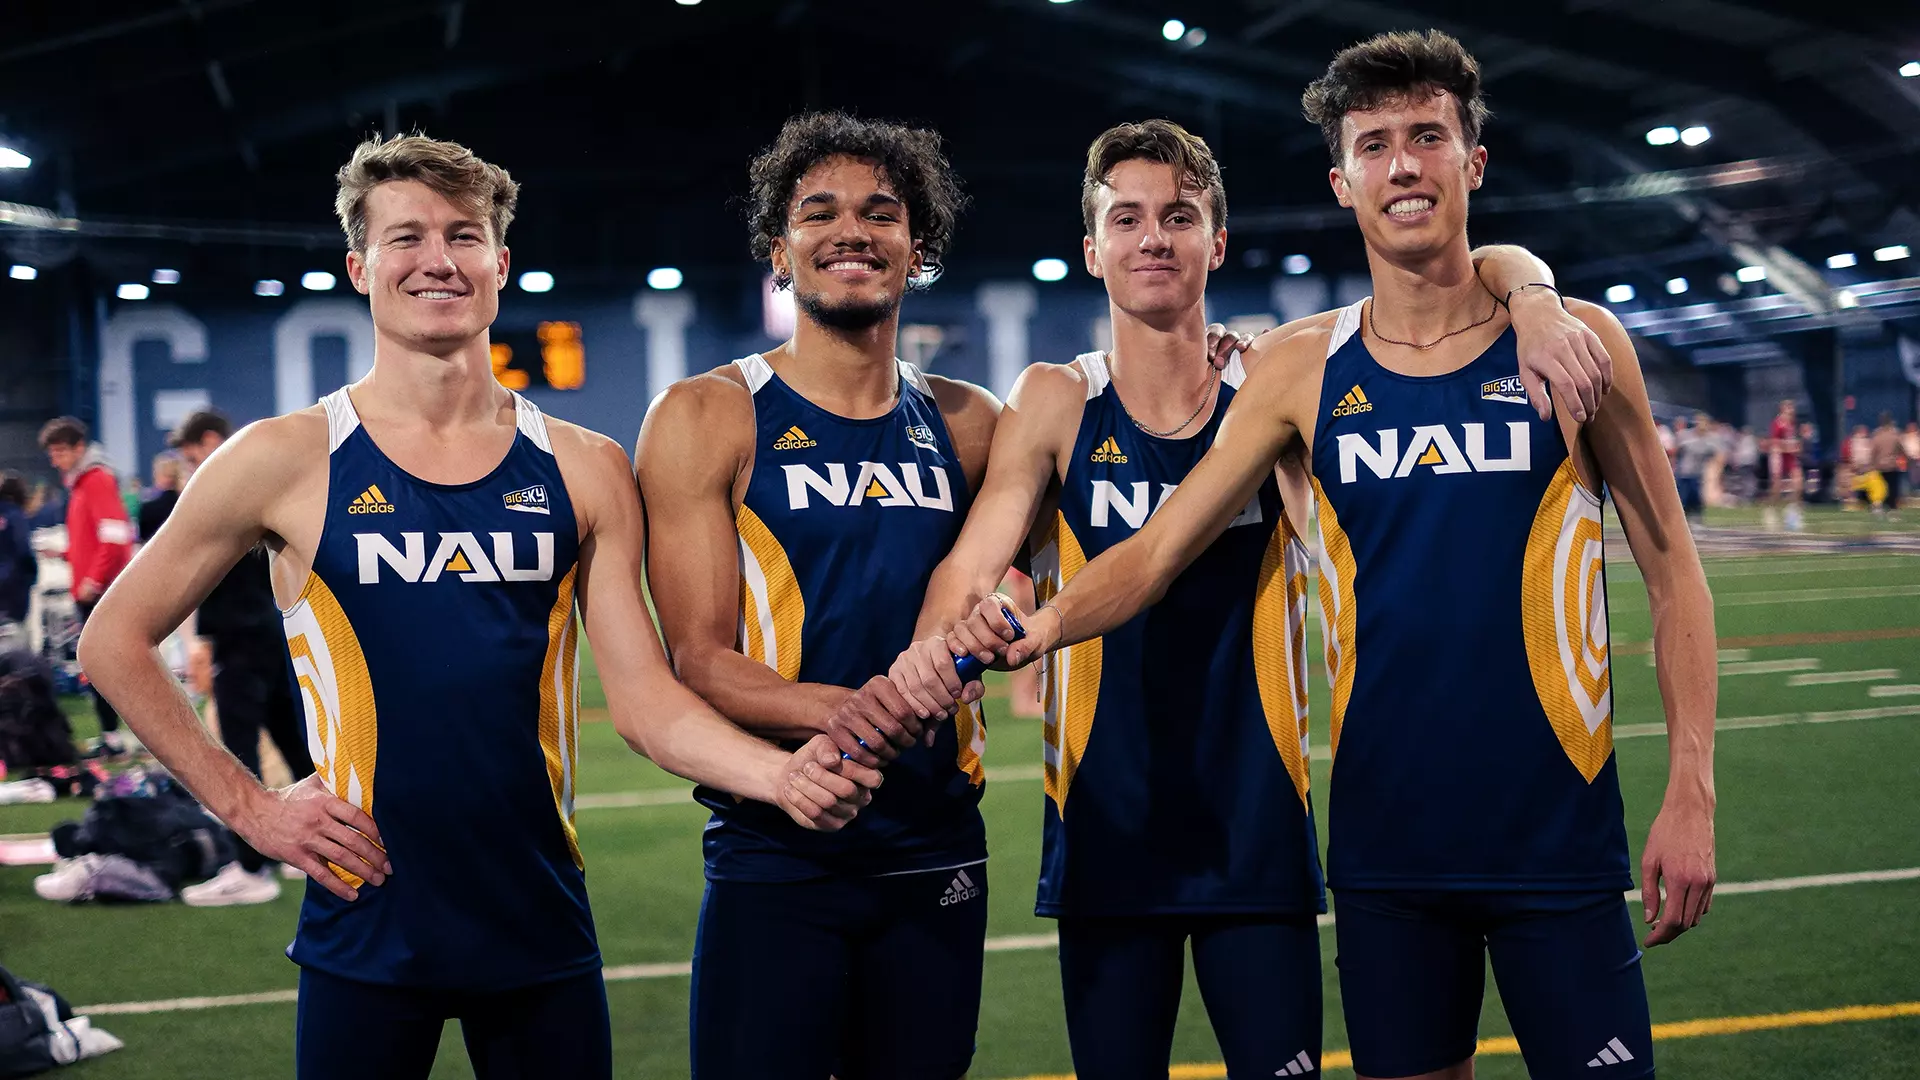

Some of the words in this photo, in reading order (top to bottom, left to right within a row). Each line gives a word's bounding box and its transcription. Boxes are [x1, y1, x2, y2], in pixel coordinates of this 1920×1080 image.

[1332, 401, 1373, 417] adidas
[773, 439, 817, 450] adidas
[1336, 422, 1531, 483] NAU
[1091, 453, 1128, 464] adidas
[780, 461, 954, 512] NAU
[348, 502, 395, 515] adidas
[352, 532, 554, 584] NAU
